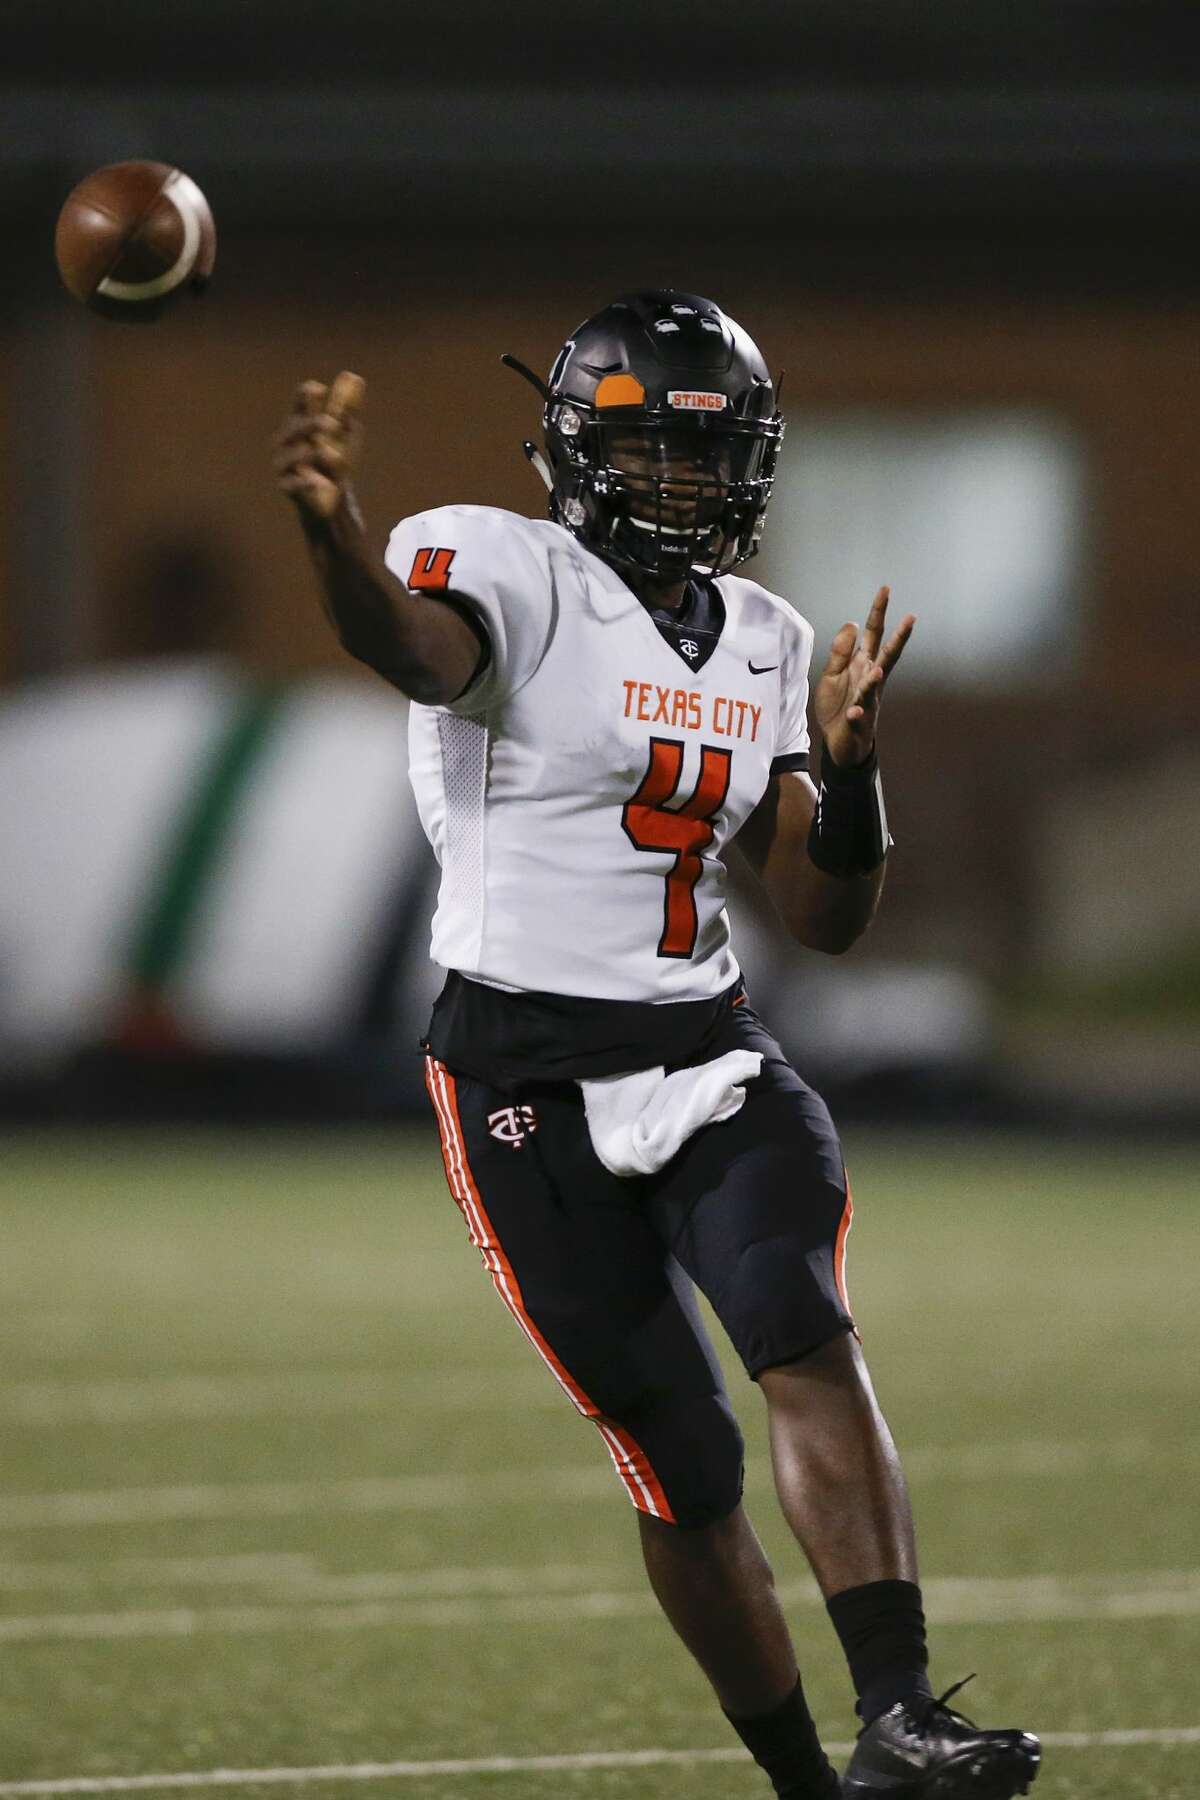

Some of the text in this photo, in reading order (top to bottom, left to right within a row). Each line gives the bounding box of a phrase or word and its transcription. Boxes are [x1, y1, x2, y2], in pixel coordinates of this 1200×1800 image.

[672, 393, 722, 408] STINGS
[407, 547, 456, 591] 4
[622, 680, 762, 742] TEXAS CITY
[621, 736, 733, 959] 4
